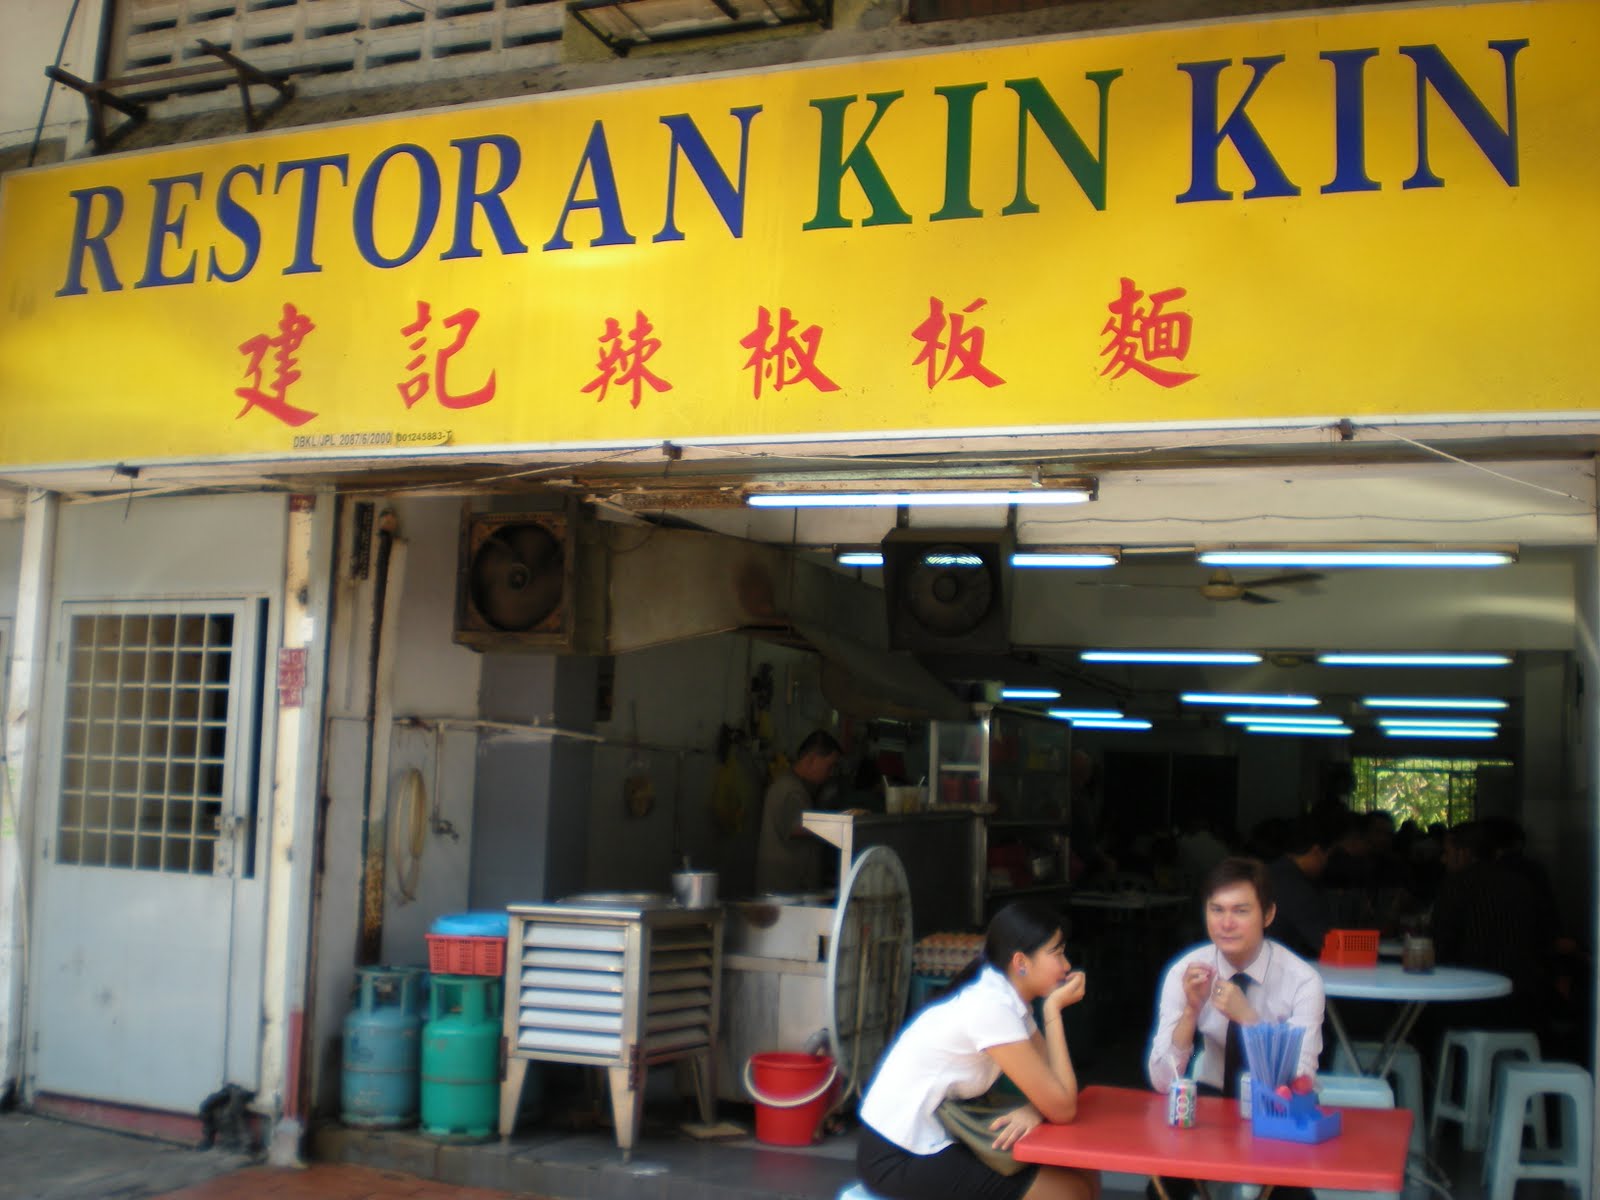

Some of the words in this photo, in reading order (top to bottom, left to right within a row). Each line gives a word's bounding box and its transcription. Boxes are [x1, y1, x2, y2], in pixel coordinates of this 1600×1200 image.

[55, 105, 763, 297] RESTORAN
[802, 68, 1123, 231] KIN
[1177, 38, 1530, 204] KIN
[235, 277, 1199, 428] 建記辣椒板麵
